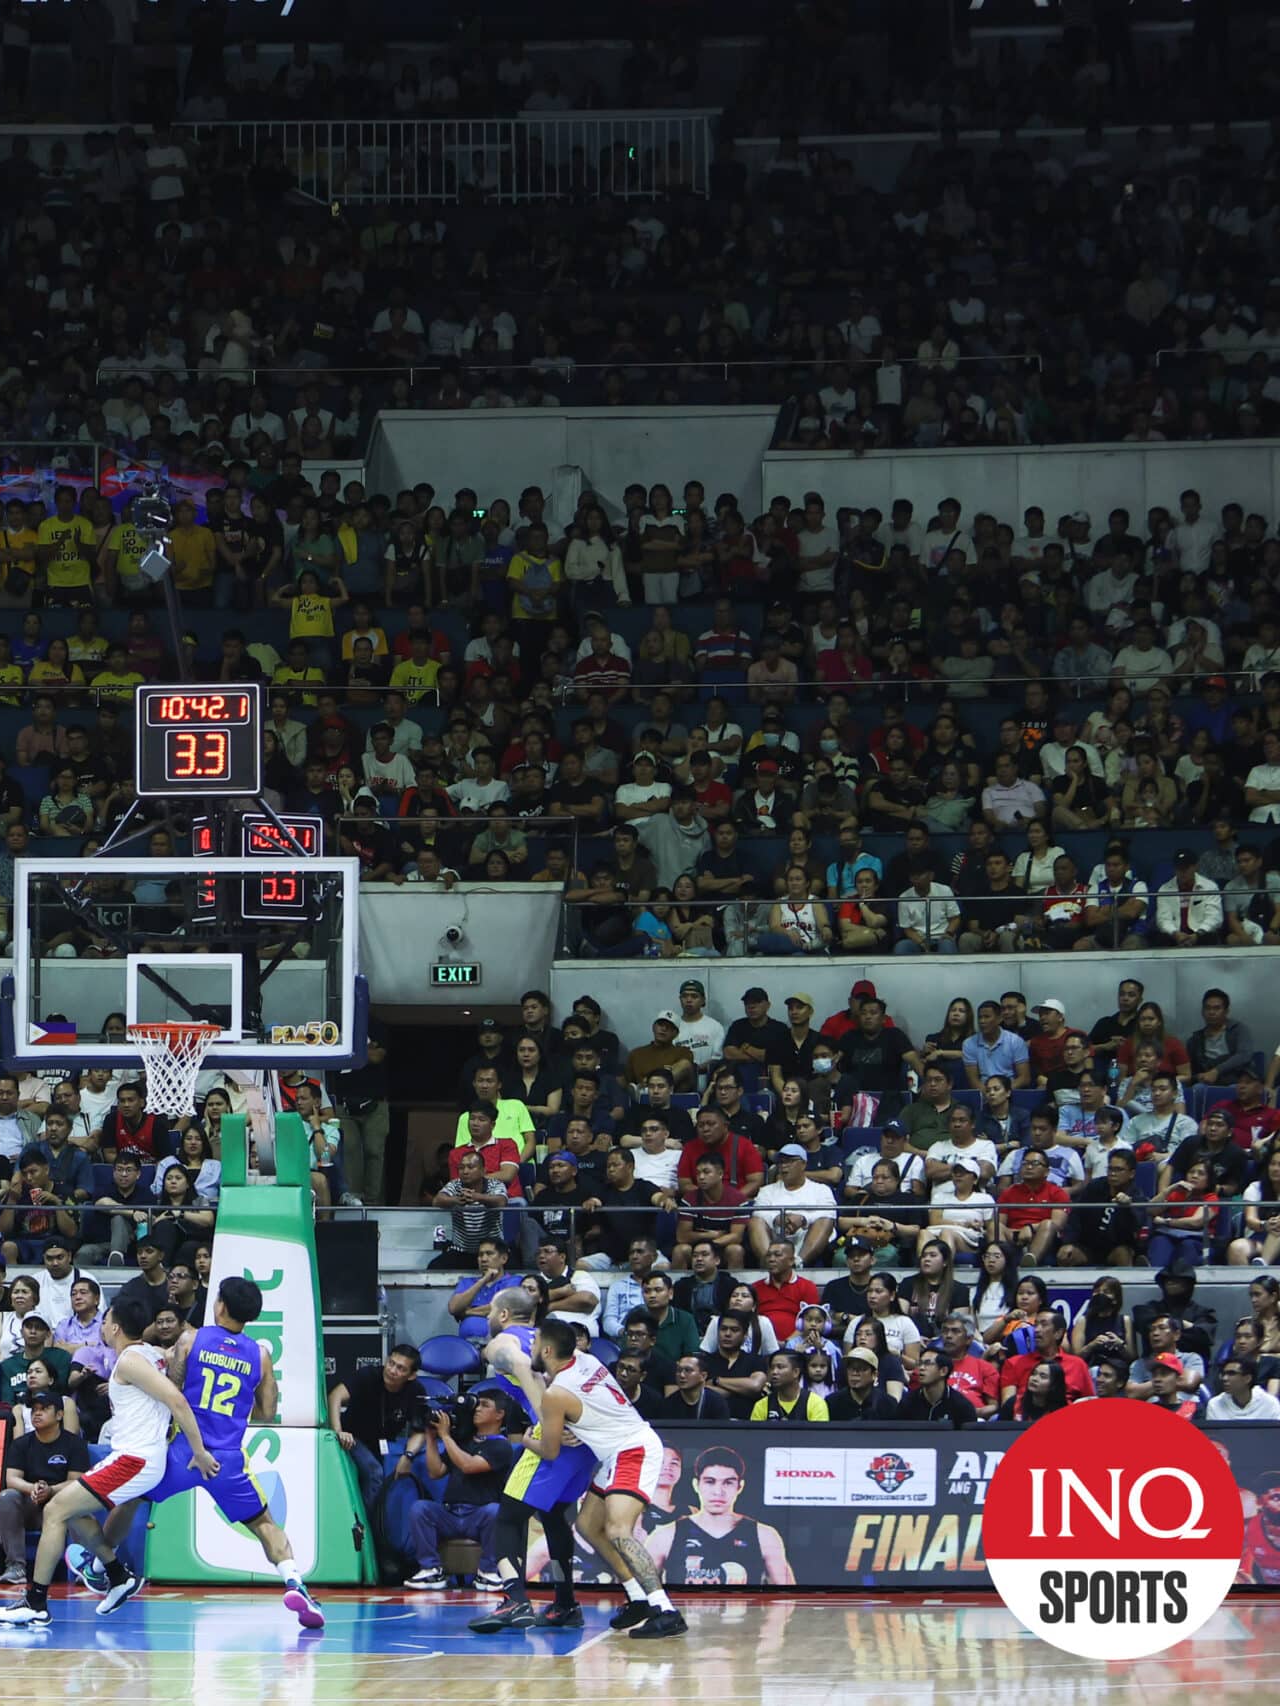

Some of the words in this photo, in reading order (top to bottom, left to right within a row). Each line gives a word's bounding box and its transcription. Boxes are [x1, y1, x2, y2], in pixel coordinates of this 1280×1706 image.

[159, 694, 248, 721] 10:42.1
[174, 734, 226, 776] 3.3
[438, 966, 473, 983] EXIT
[198, 1349, 253, 1377] KHOBUNTIN
[198, 1366, 242, 1418] 12
[775, 1469, 837, 1480] HONDA
[948, 1482, 972, 1496] ANG
